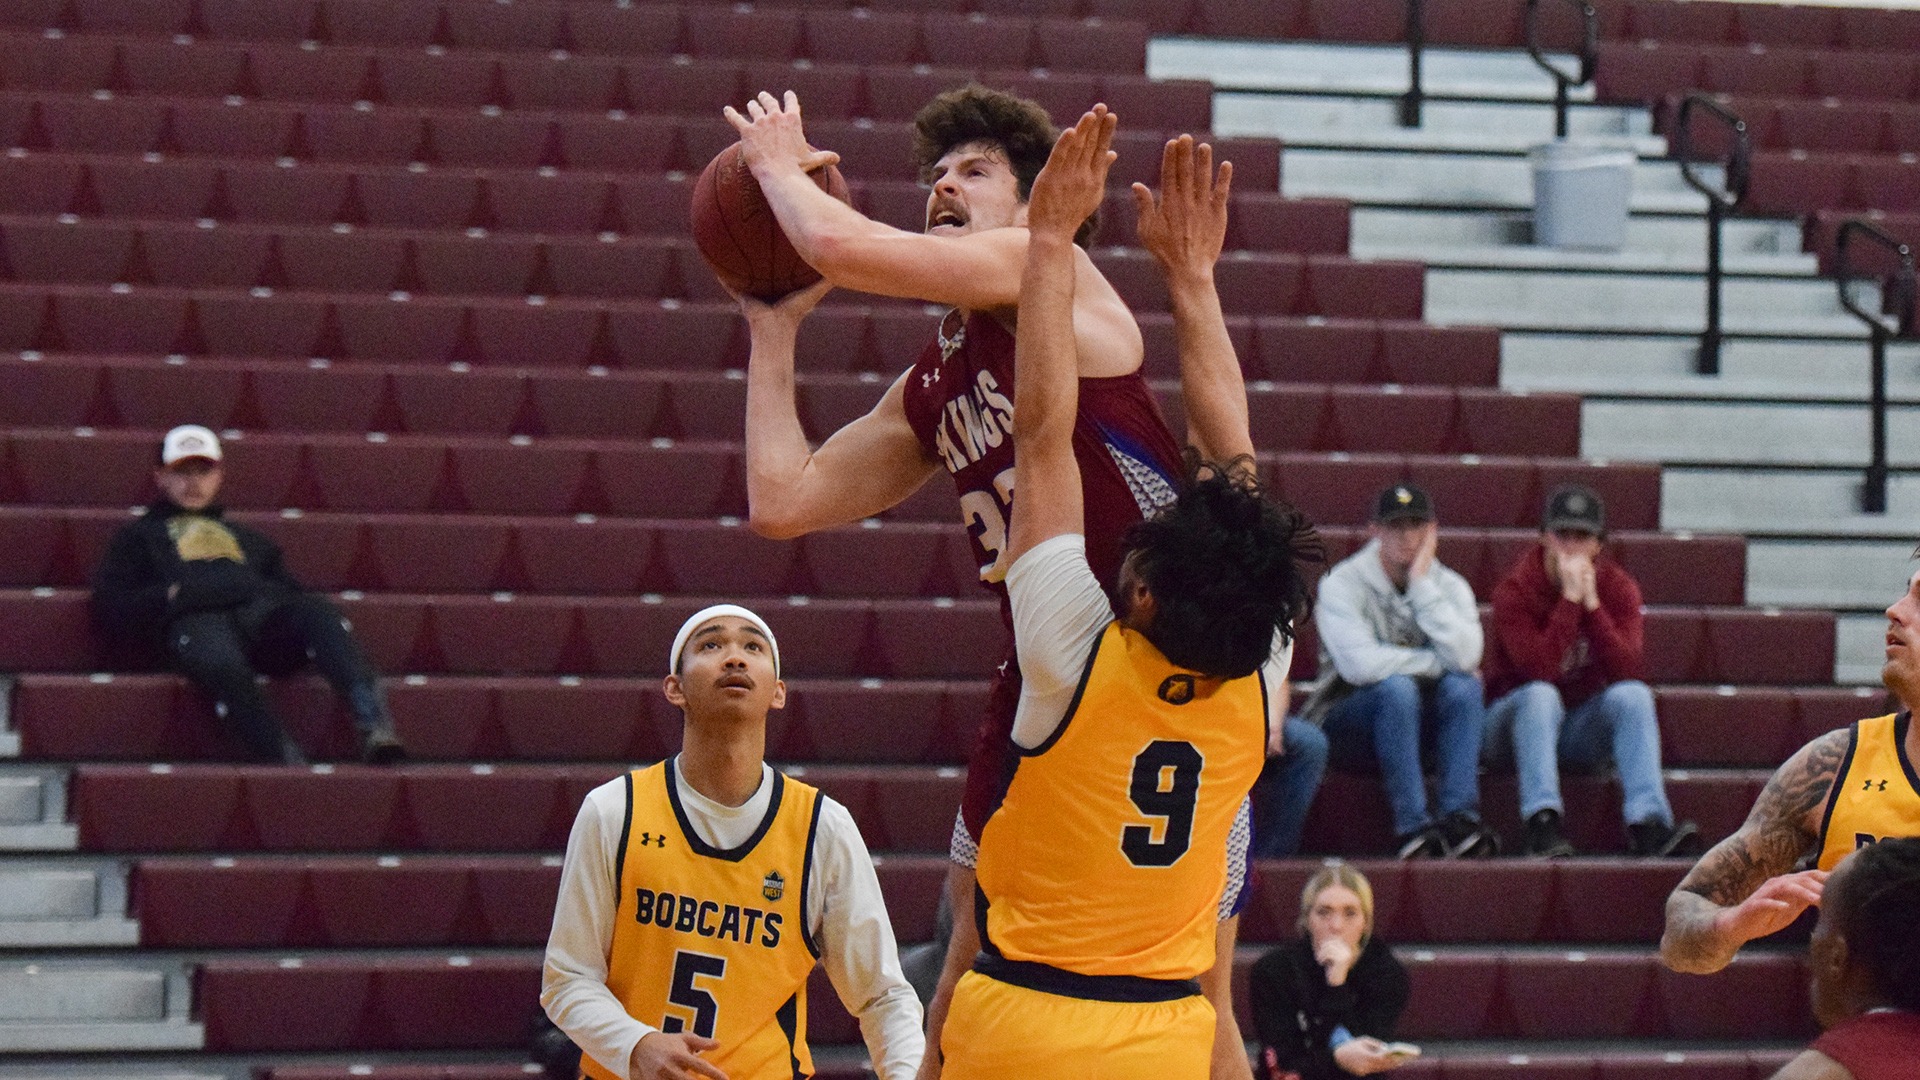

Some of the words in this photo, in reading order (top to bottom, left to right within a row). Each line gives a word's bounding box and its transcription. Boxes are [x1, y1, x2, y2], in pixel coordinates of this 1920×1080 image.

[1120, 738, 1204, 868] 9
[635, 887, 783, 948] BOBCATS
[764, 888, 781, 898] WEST
[662, 949, 727, 1039] 5
